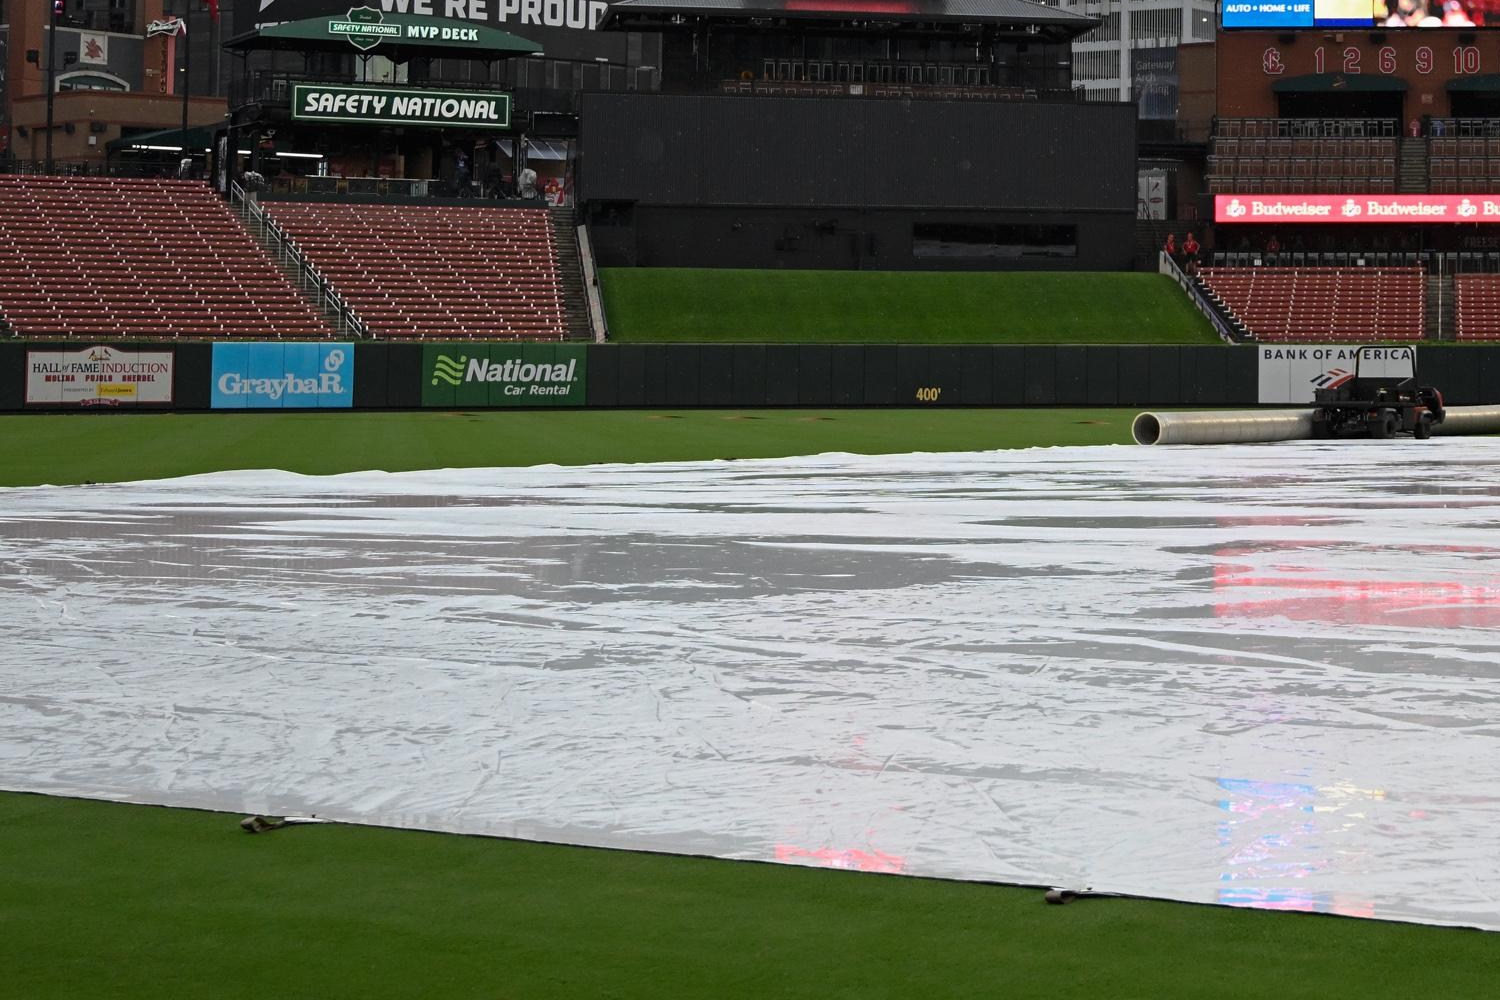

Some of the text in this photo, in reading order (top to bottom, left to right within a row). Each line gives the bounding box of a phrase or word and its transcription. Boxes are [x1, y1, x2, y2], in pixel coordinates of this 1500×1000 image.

[1226, 4, 1310, 12] AUTO HOME LIFE
[333, 23, 479, 41] SAFETY NATIONAL MVP DECK
[1315, 47, 1325, 74] 1
[1343, 47, 1361, 74] 2
[1378, 47, 1397, 74] 6
[1415, 47, 1434, 74] 9
[1453, 47, 1480, 74] 10
[305, 92, 499, 120] SAFETY NATIONAL
[1251, 202, 1332, 216] Budweiser
[1367, 202, 1447, 216] Budweiser
[1264, 349, 1411, 360] BANK OF AMERICA
[33, 362, 168, 373] HALL of FAME INDUCTION
[465, 358, 576, 383] National
[45, 374, 75, 382] MOLINA
[504, 384, 570, 396] Car Rental
[916, 387, 941, 401] 400'
